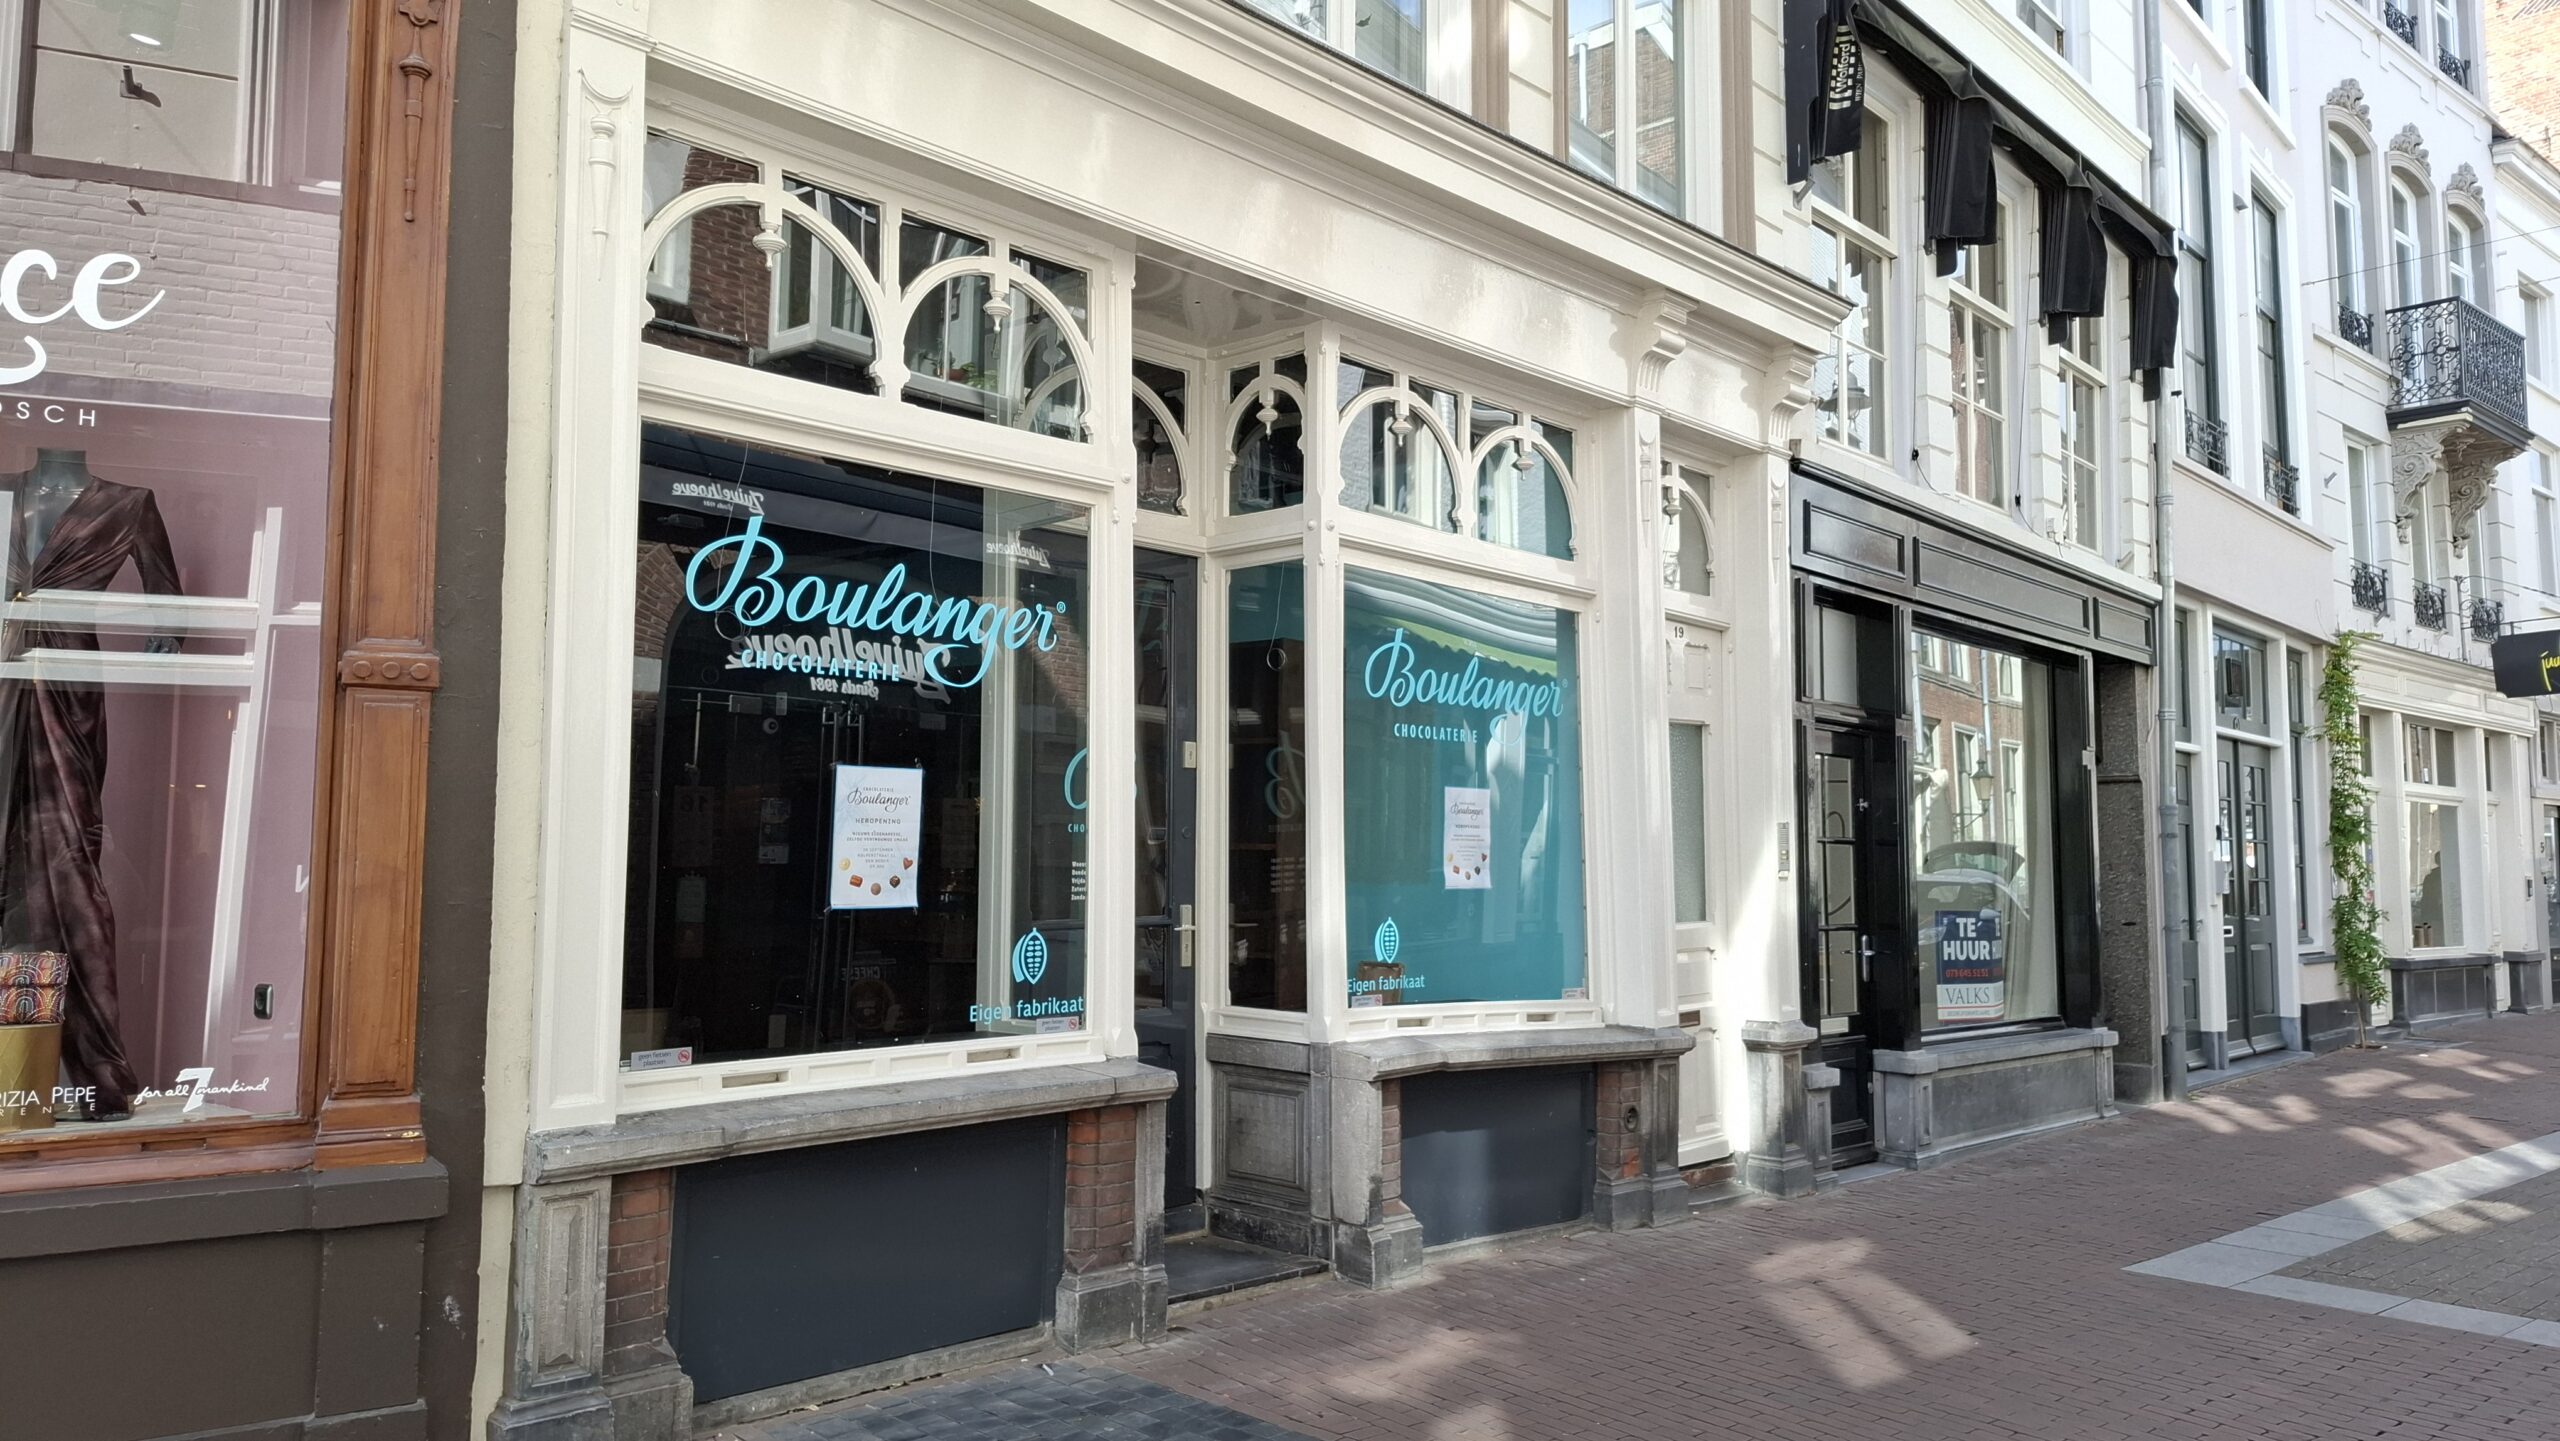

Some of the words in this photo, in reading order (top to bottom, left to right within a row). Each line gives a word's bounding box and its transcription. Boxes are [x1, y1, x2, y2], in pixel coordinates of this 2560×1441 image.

[1836, 43, 1850, 93] Wolford
[0, 401, 96, 427] SCH
[1674, 626, 1684, 638] 19
[741, 649, 900, 683] CHOCOLATERIE
[1393, 723, 1478, 744] CHOCOLATERIE
[1956, 917, 1977, 938] TE
[1943, 940, 1991, 961] HUUR
[1347, 976, 1376, 996] Eigen
[1378, 974, 1426, 991] fabrikaat
[1946, 987, 1991, 1005] VALKS
[969, 1004, 1012, 1025] Eigen
[1016, 996, 1085, 1018] fabrikaat
[51, 1085, 97, 1105] PEPE
[136, 1089, 162, 1105] for
[164, 1084, 189, 1097] all
[175, 1068, 215, 1113] 7
[194, 1077, 270, 1097] mankind
